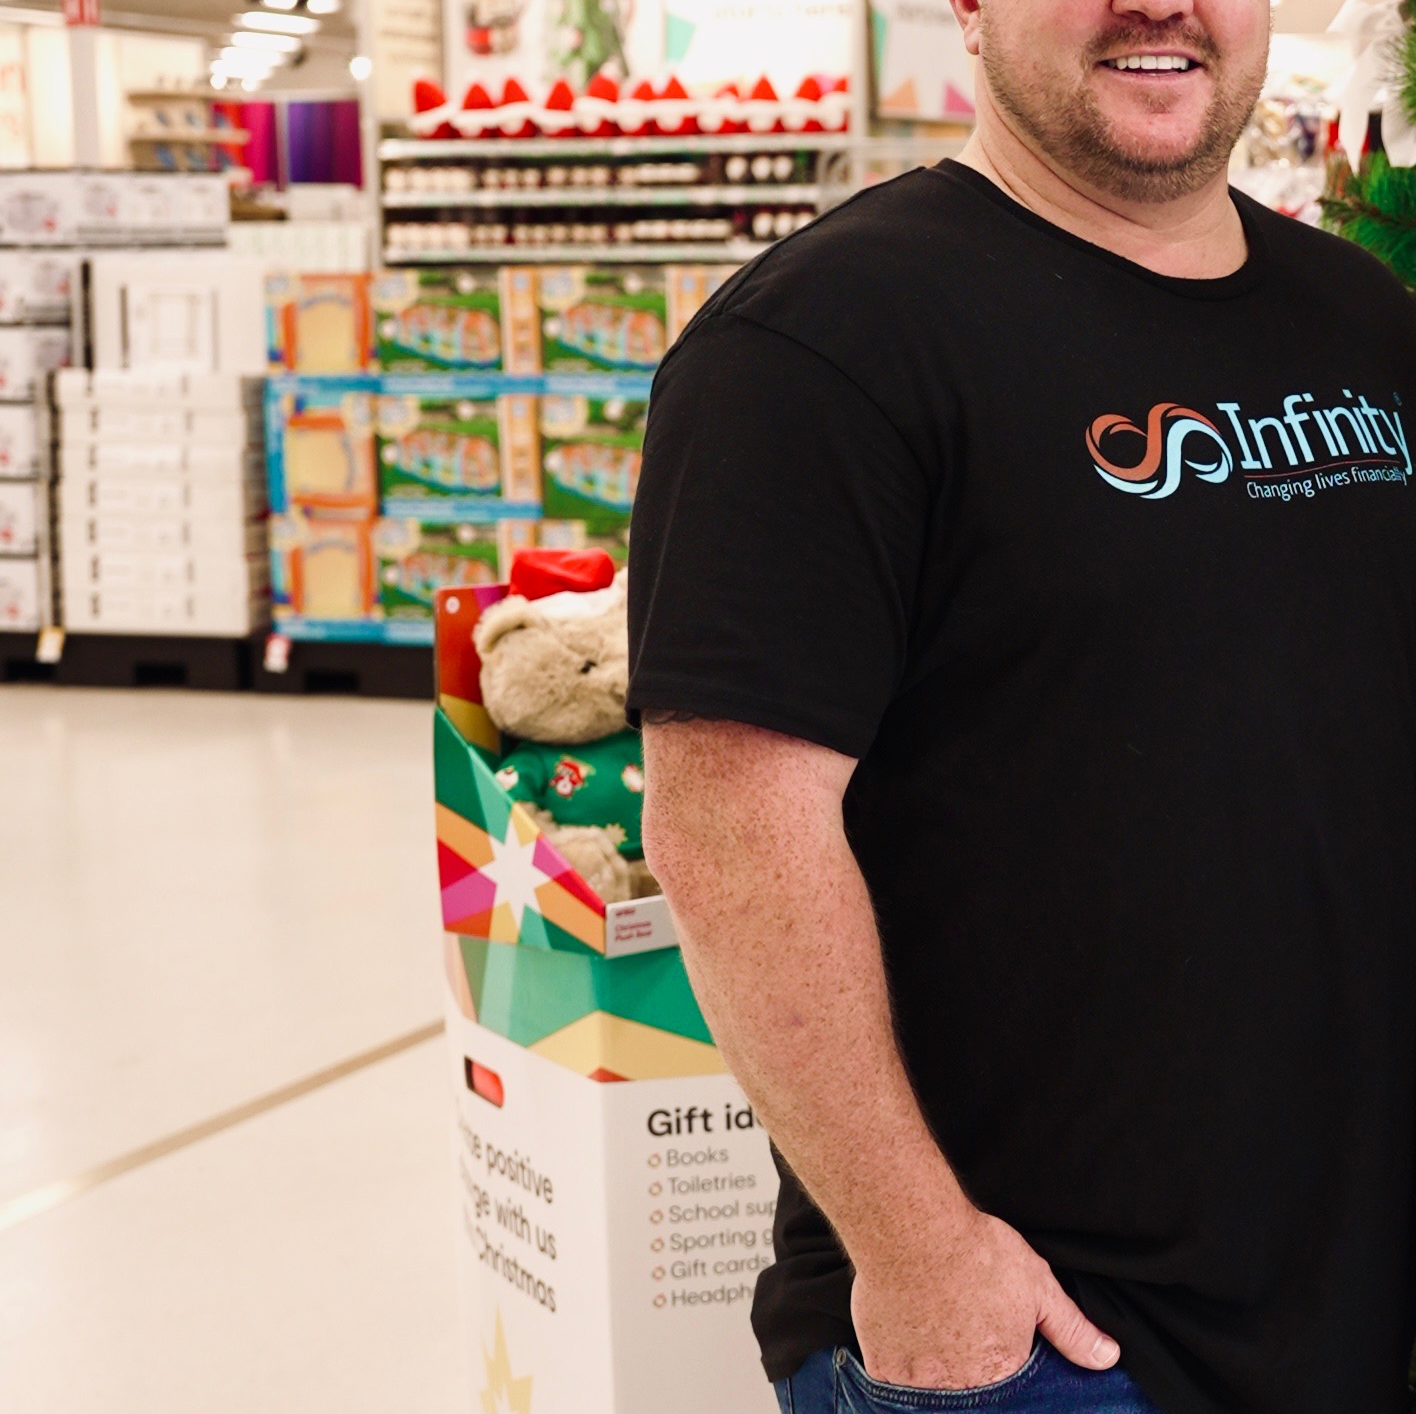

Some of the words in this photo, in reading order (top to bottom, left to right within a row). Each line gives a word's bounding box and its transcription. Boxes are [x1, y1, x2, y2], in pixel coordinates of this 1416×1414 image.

[1216, 388, 1413, 476] Infinity
[1246, 478, 1315, 501] Changing
[1315, 471, 1351, 489] lives
[647, 1106, 713, 1137] Gift
[666, 1146, 729, 1168] Books
[486, 1142, 554, 1205] positive
[668, 1173, 757, 1196] Toiletries
[669, 1200, 739, 1223] School
[495, 1197, 531, 1244] with
[535, 1225, 557, 1261] us
[670, 1230, 757, 1254] Sporting
[670, 1260, 707, 1279] Gift
[713, 1254, 770, 1275] cards
[671, 1283, 754, 1307] Headph
